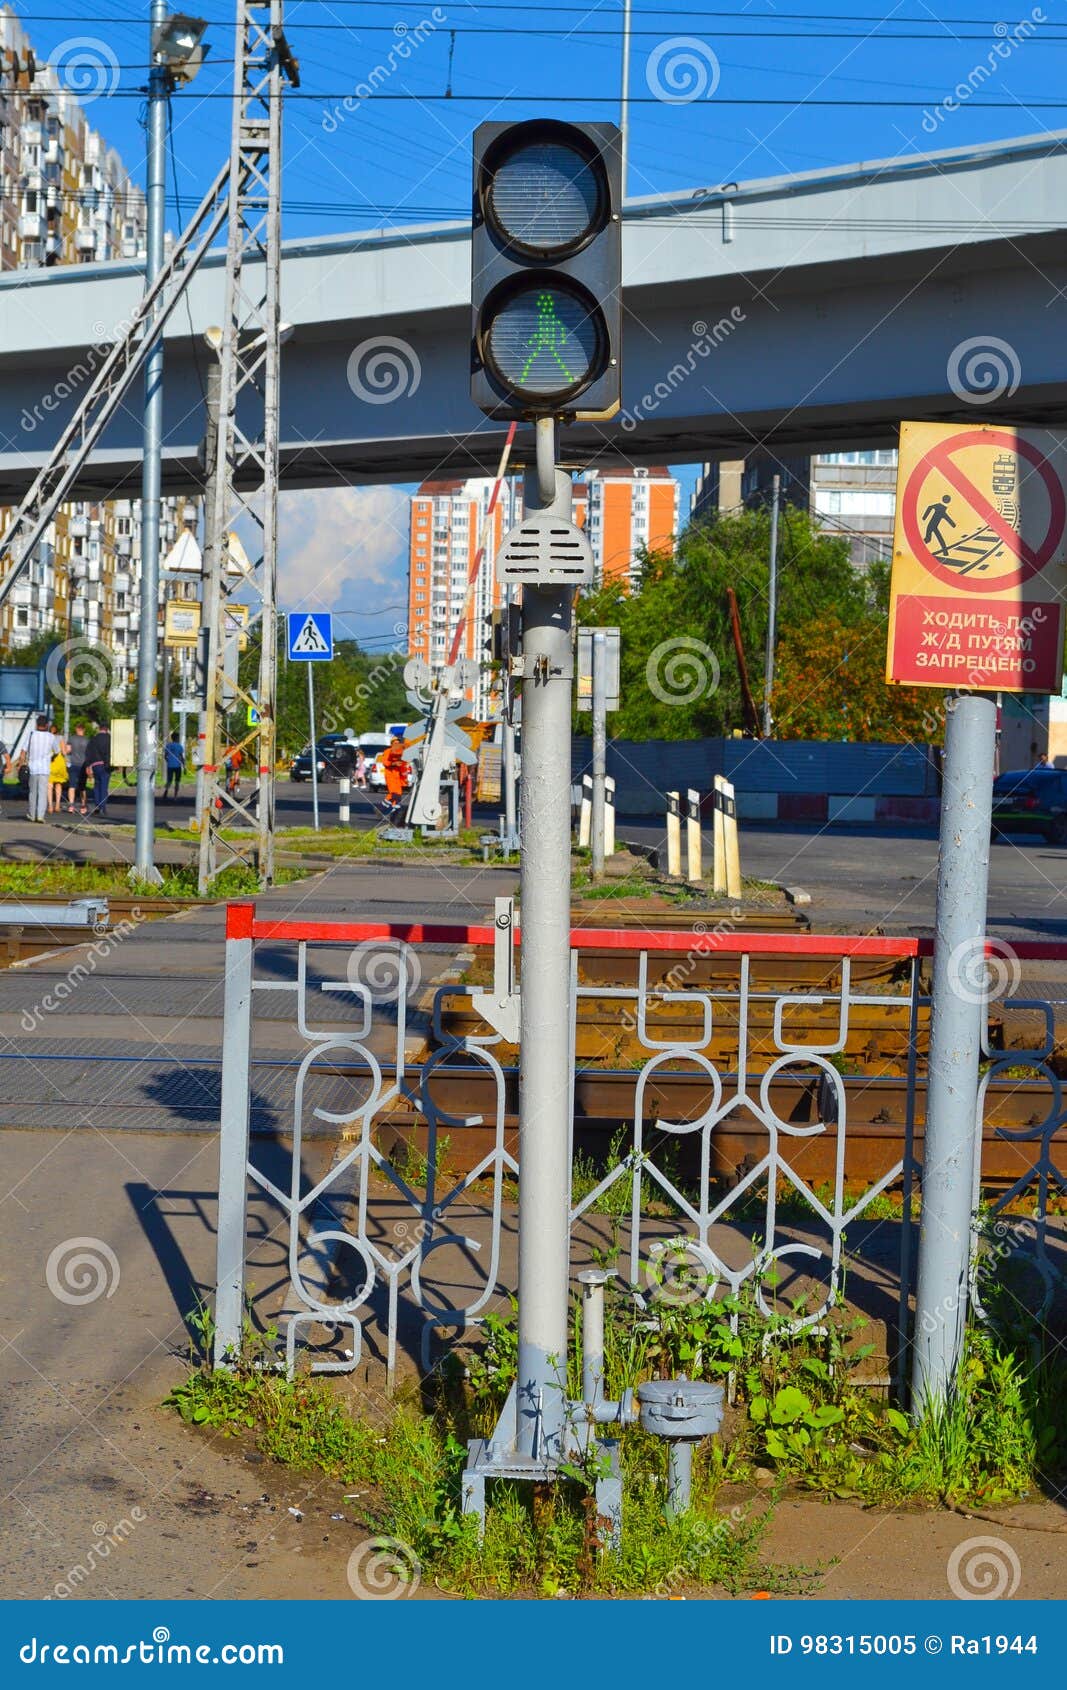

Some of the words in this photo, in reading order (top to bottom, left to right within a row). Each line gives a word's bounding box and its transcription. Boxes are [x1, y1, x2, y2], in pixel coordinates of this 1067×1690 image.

[922, 611, 1000, 630] ХОДИТЬ
[921, 631, 961, 650] Ж/Д
[968, 634, 1032, 651] ПУТЯМ
[915, 652, 1036, 673] ЗАПРЕЩЕНО
